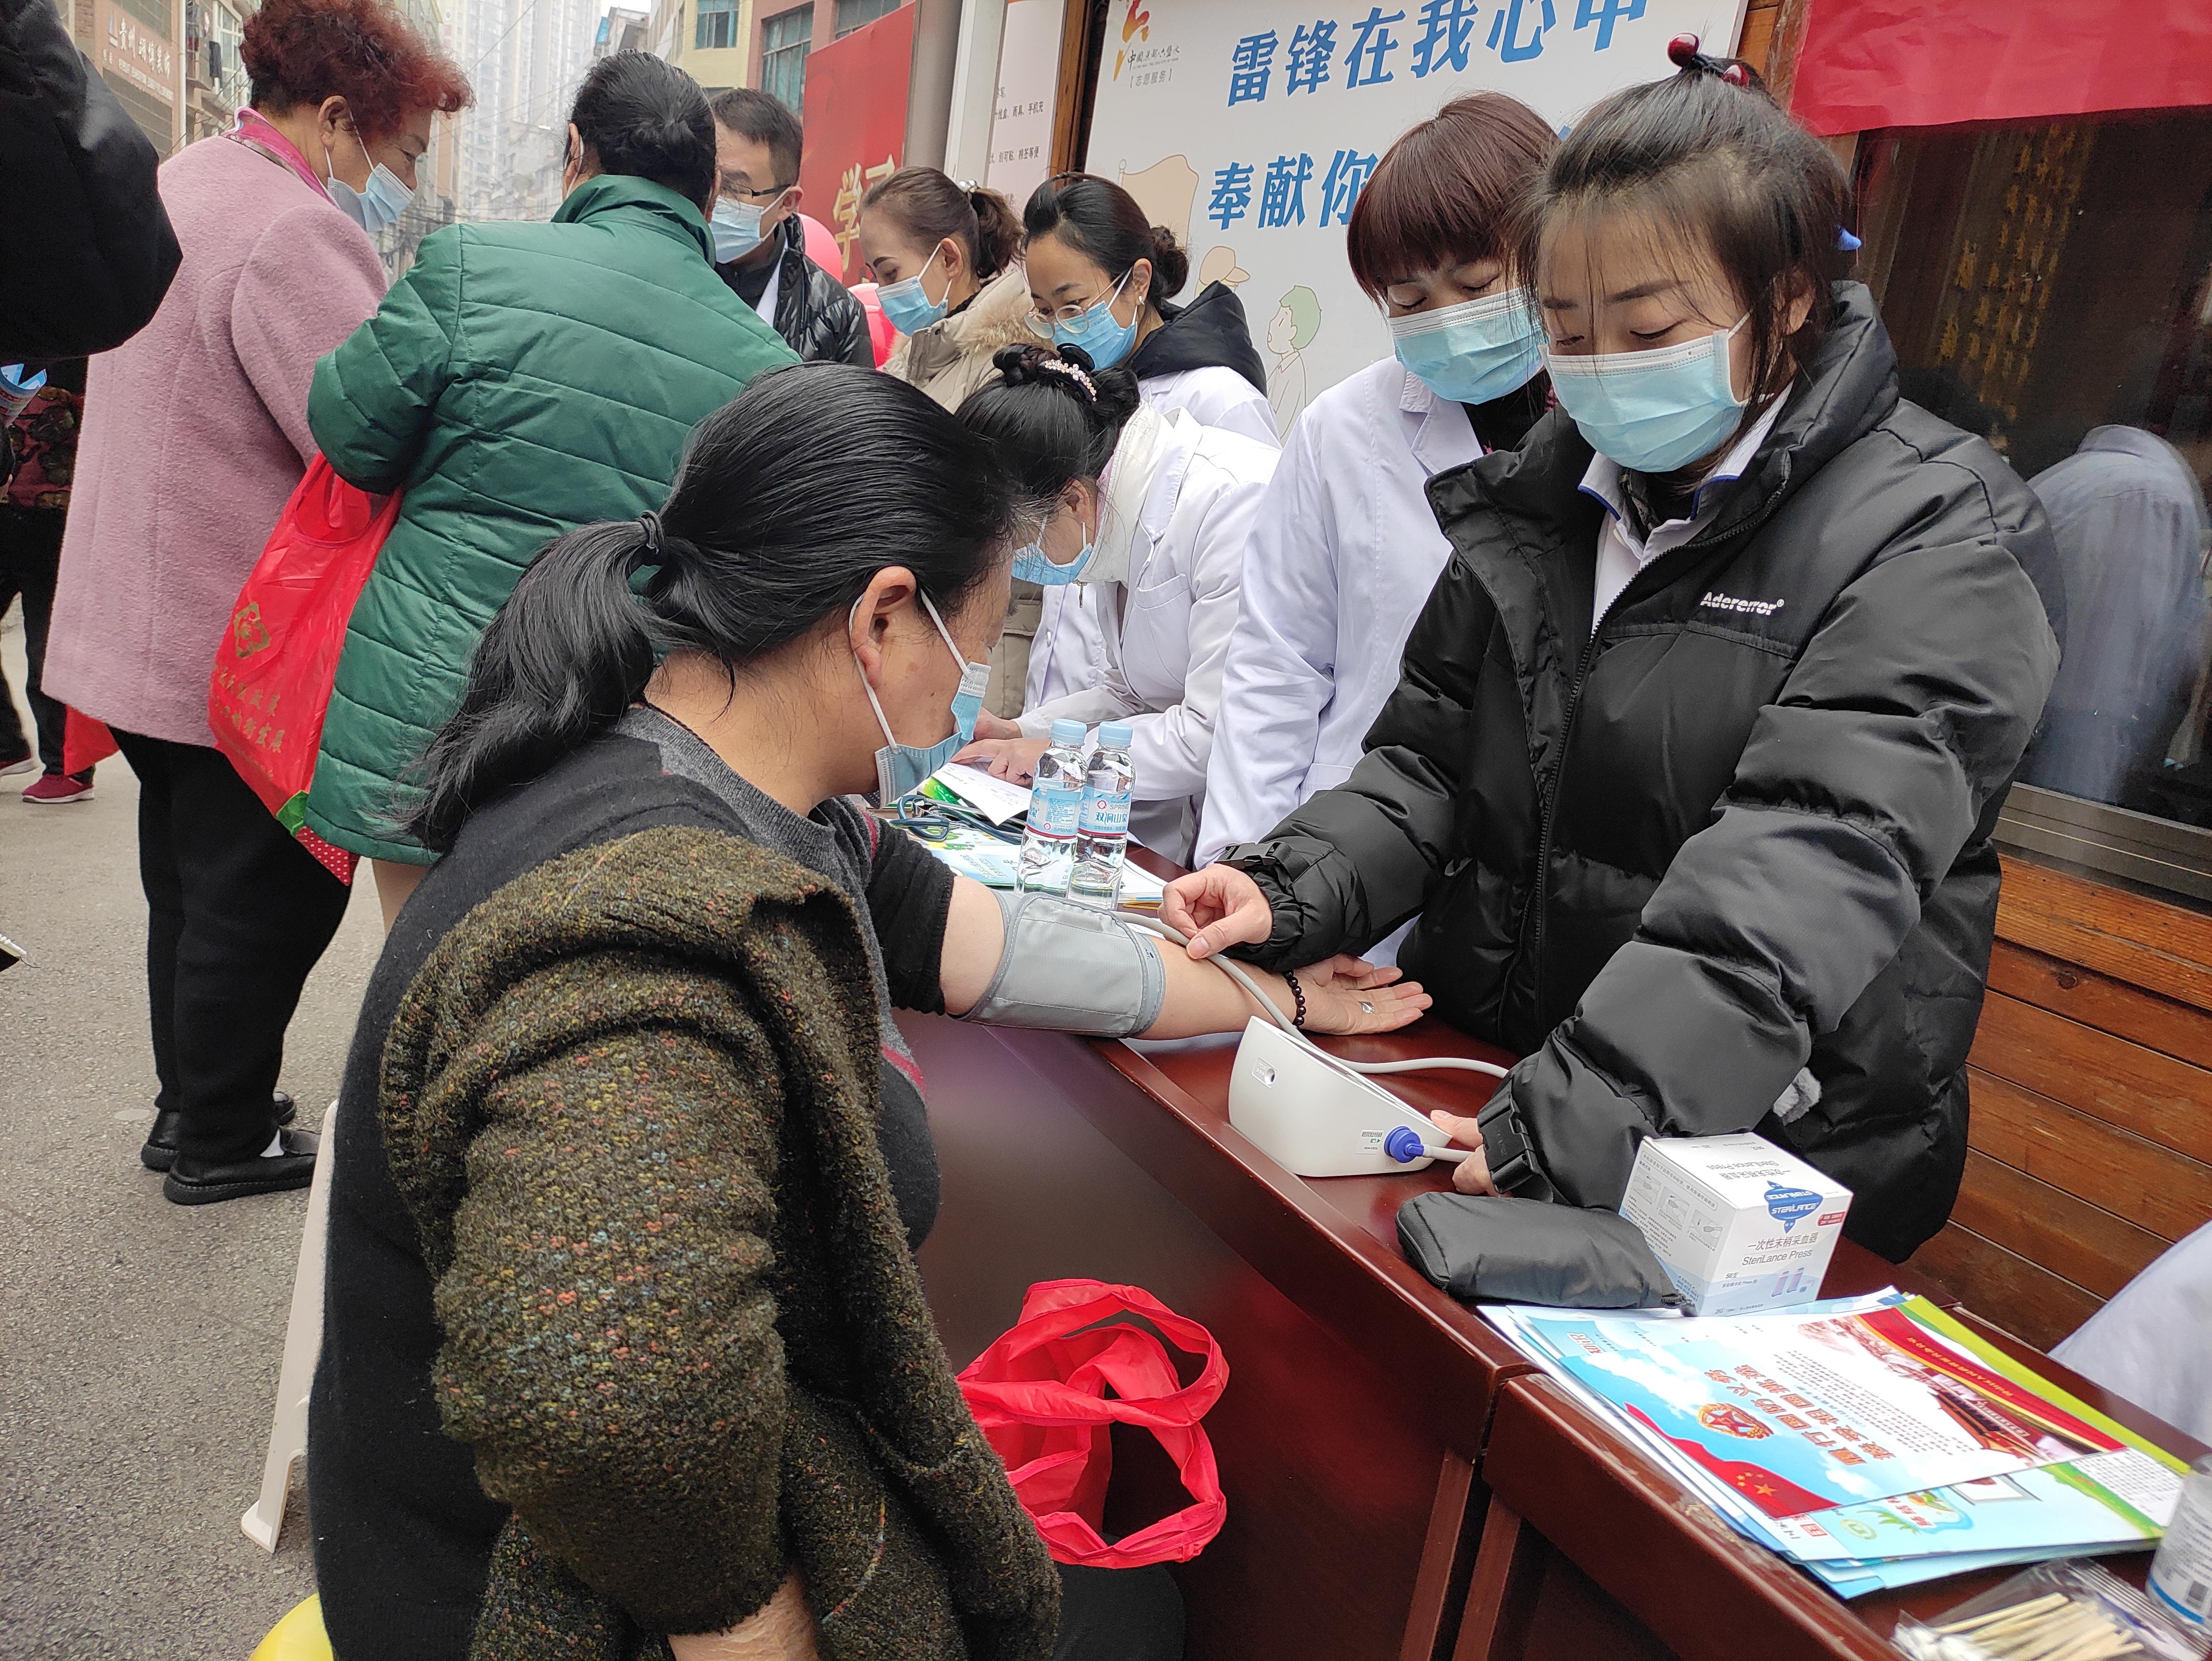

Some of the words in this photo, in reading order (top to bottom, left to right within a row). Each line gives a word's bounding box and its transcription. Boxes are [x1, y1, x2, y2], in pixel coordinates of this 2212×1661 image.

[1228, 0, 1648, 107] 雷锋在我心中
[1742, 1253, 1788, 1266] SteriLance
[1789, 1250, 1813, 1260] Press
[1704, 1370, 1868, 1465] 履行国防义务
[1734, 1365, 1897, 1460] 接受祖国挑选
